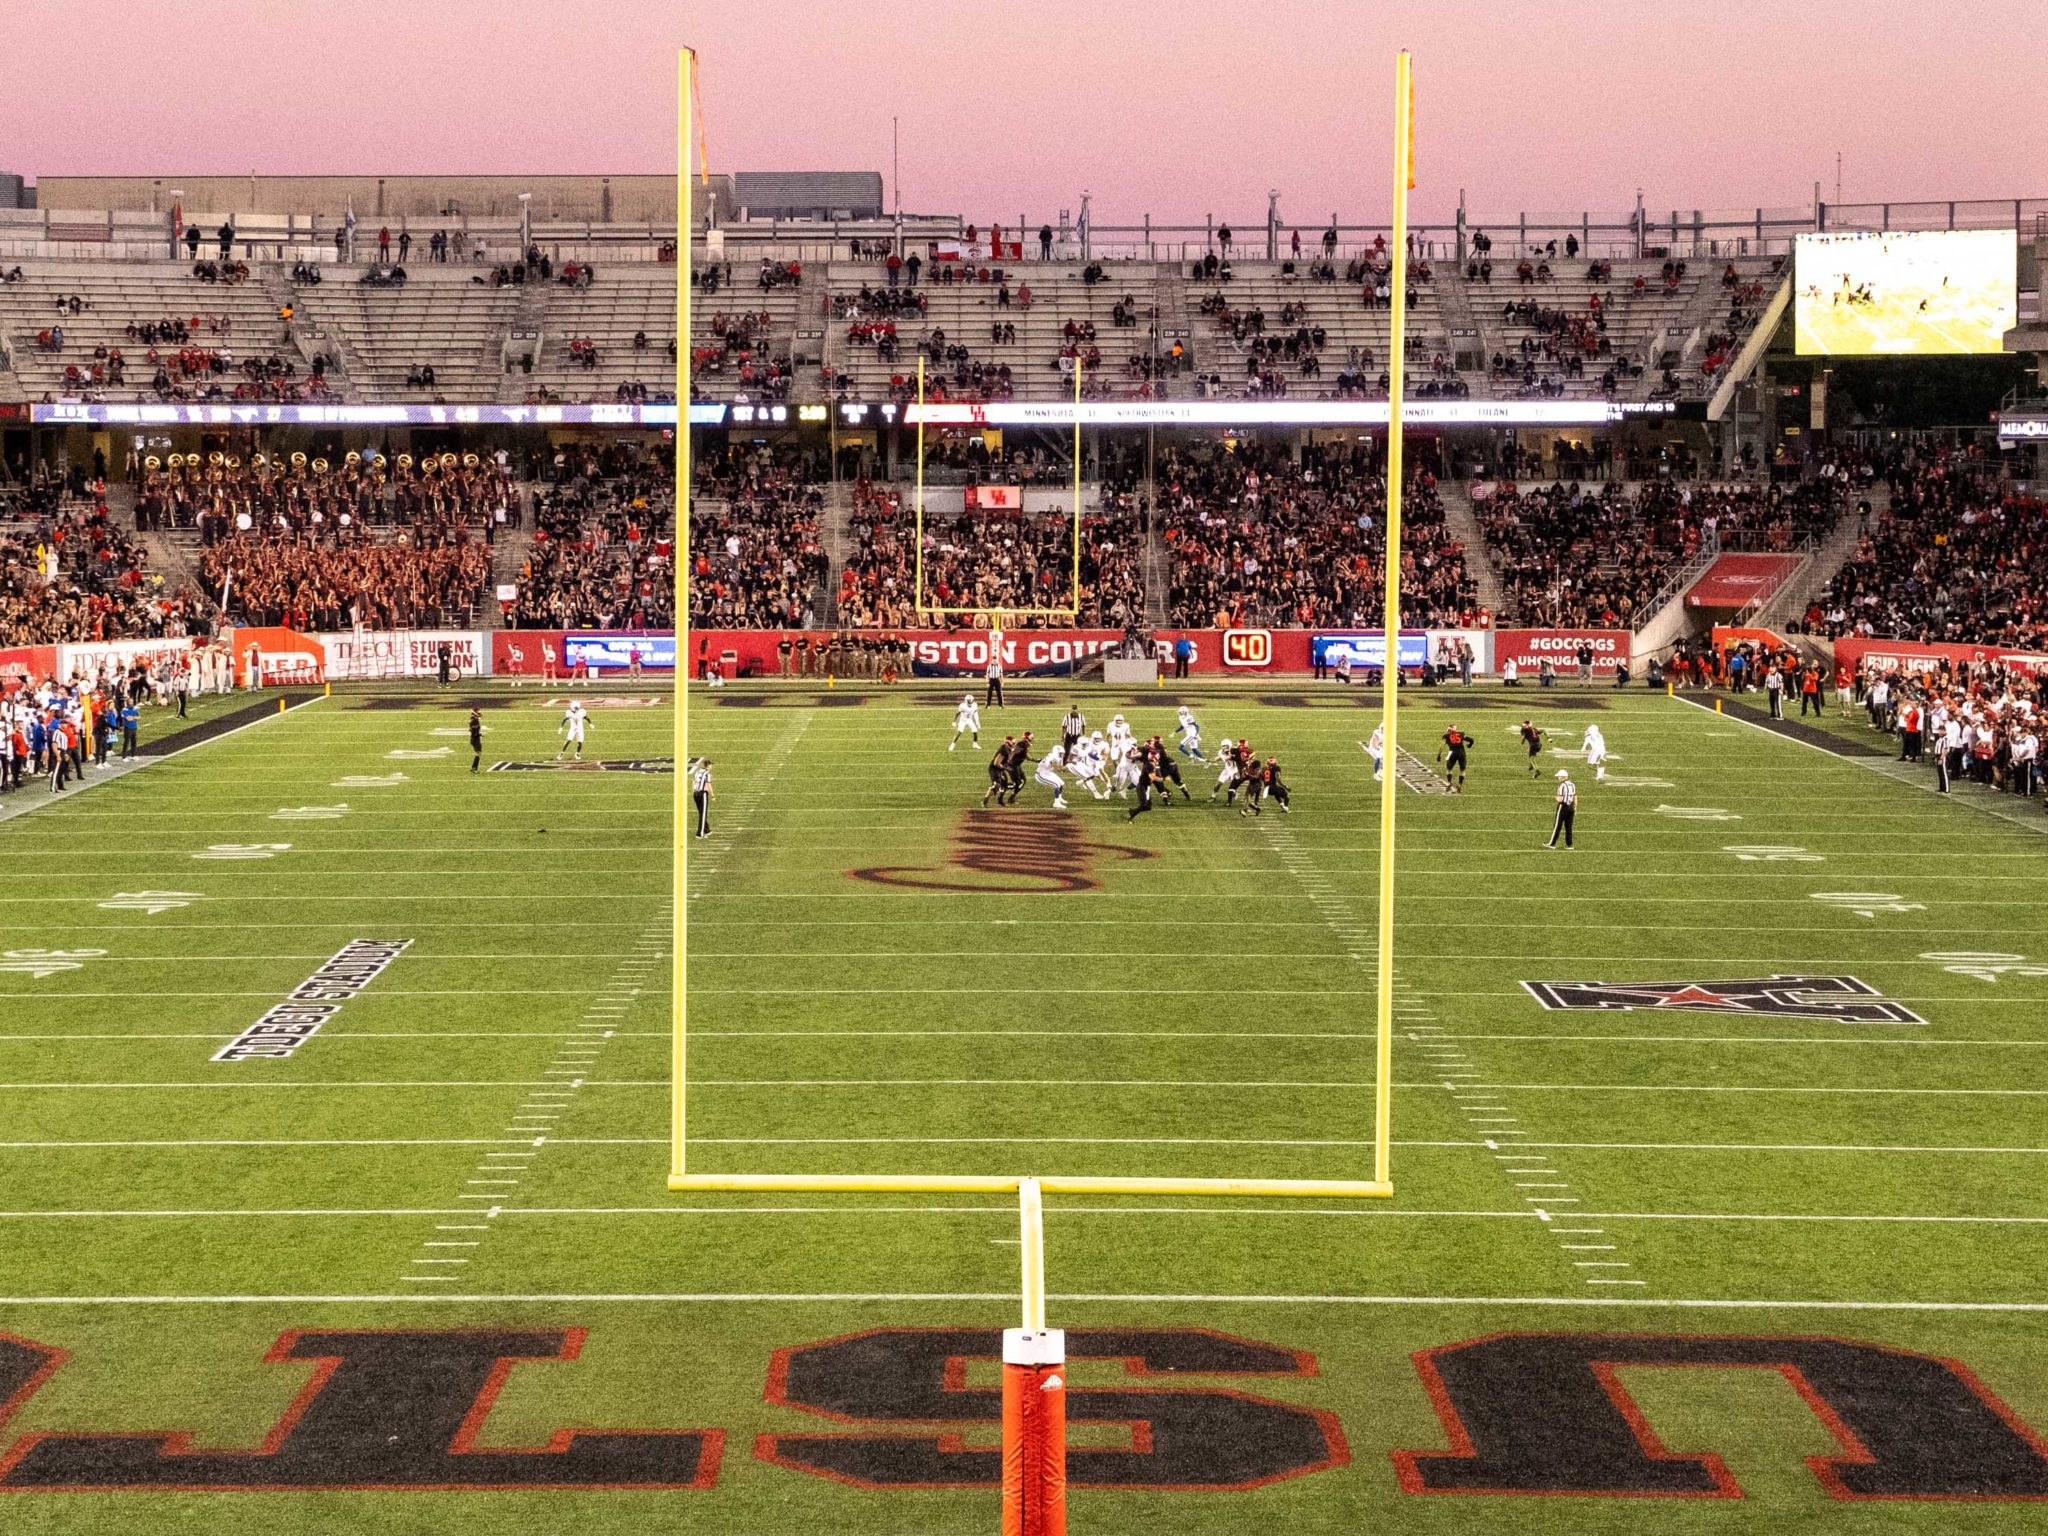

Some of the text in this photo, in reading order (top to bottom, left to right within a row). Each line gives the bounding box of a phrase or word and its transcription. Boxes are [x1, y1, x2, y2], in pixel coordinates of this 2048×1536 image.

[1621, 403, 1645, 412] FIRST
[1645, 403, 1663, 412] AND
[1664, 403, 1675, 412] 10
[2001, 422, 2048, 436] MEMORI
[1028, 641, 1198, 664] COUR
[1231, 635, 1264, 660] 40
[1530, 637, 1616, 651] #GOCOOGS
[411, 654, 473, 668] SECON
[1518, 655, 1627, 667] UHCUGAS.COM
[1867, 656, 1898, 671] BUD
[190, 843, 294, 860] 50
[1722, 845, 1826, 862] 50
[97, 890, 205, 910] 40
[1808, 892, 1928, 912] 40
[0, 948, 108, 973] 30
[1917, 952, 2048, 977] 30
[210, 938, 415, 1061] TDECU STADIUM
